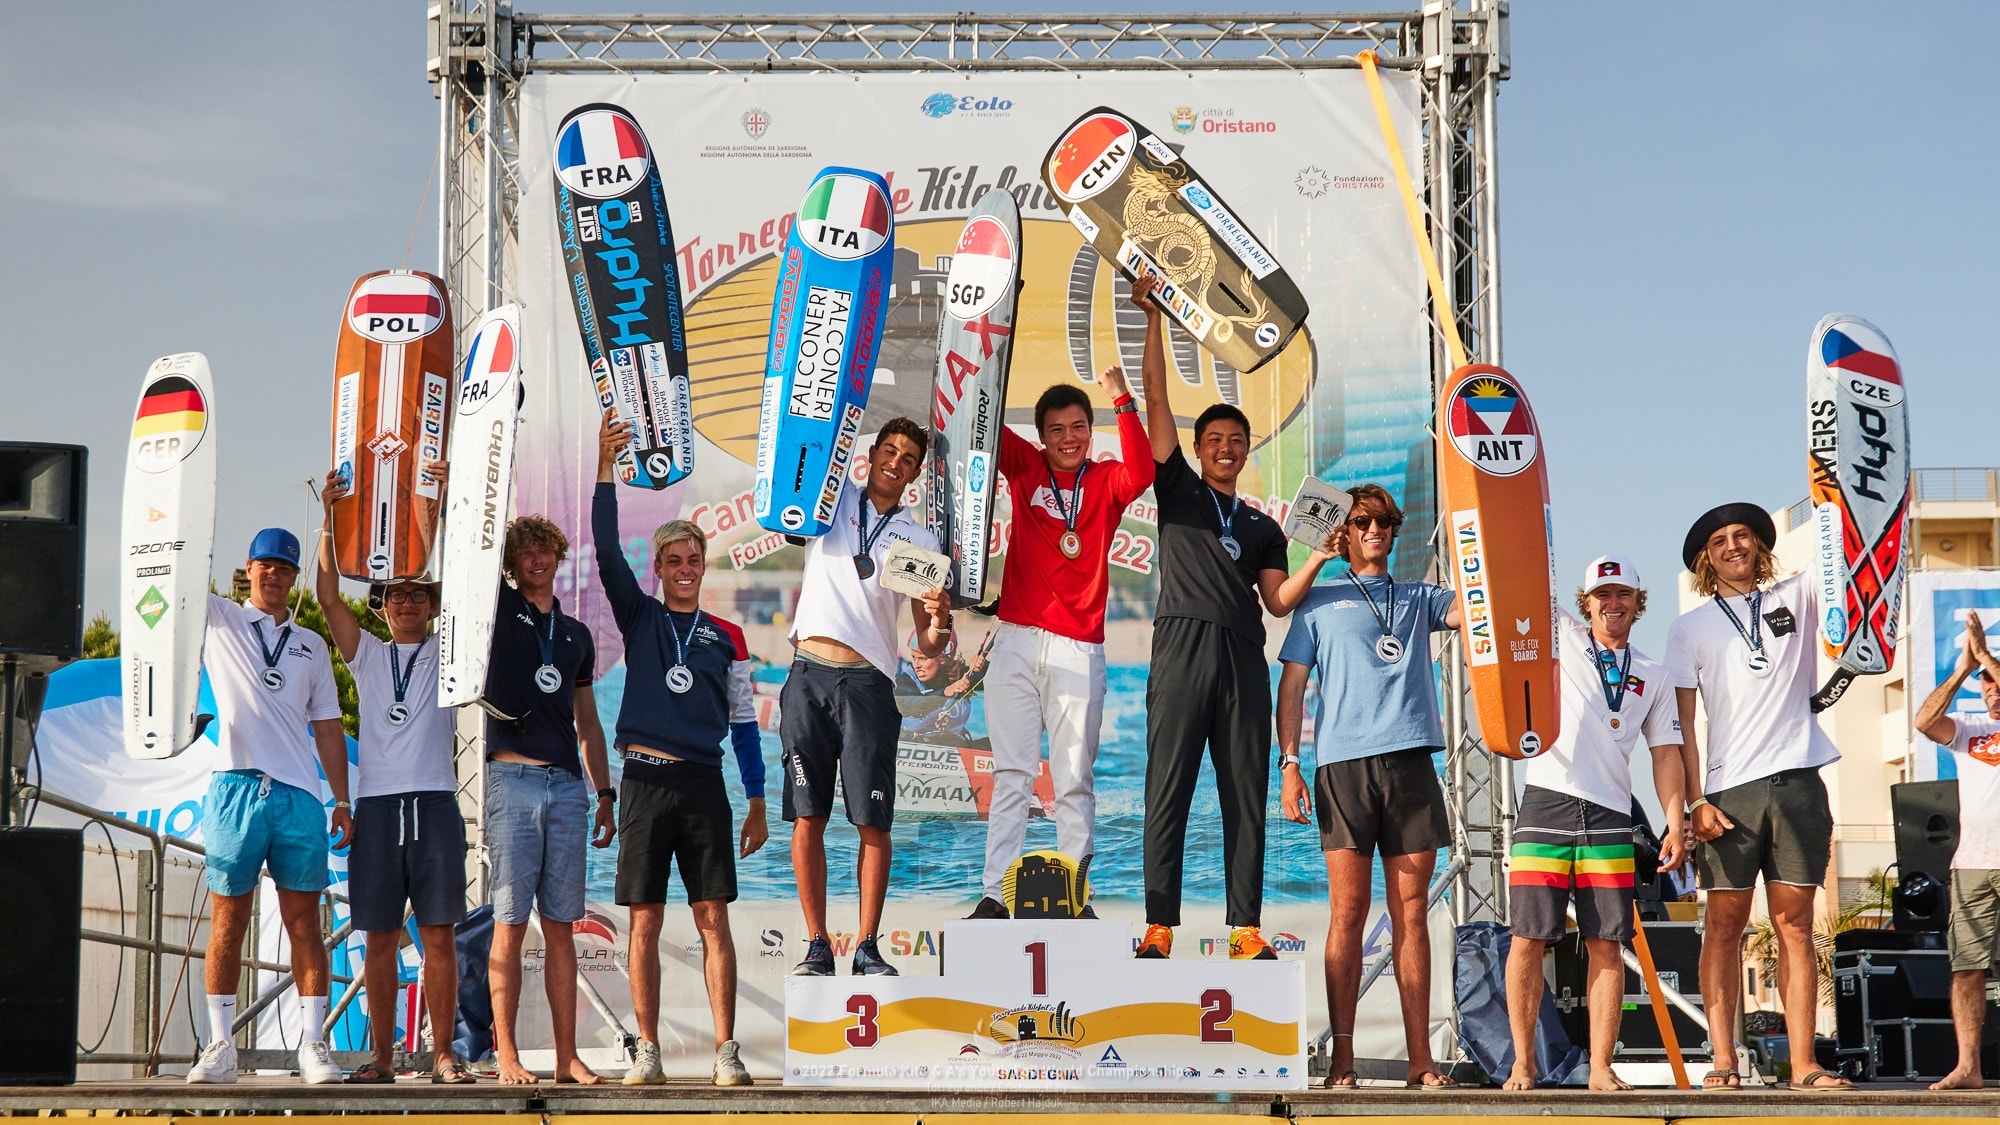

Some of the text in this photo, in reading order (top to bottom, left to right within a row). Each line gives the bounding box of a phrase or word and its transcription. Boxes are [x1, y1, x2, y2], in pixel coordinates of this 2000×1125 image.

[959, 96, 1015, 111] Eolo
[1203, 108, 1234, 117] città di
[1203, 119, 1277, 133] Oristano
[581, 165, 632, 188] FRA
[1081, 144, 1126, 190] CHN
[819, 226, 859, 249] ITA
[1212, 207, 1273, 272] TORREGRANDE
[1217, 227, 1247, 259] ORISTANO
[573, 271, 596, 335] KITECENTER
[663, 262, 684, 352] SPOT KITECENTER
[775, 247, 800, 349] GROOVE
[951, 284, 985, 305] SGP
[369, 317, 420, 333] POL
[790, 286, 828, 417] FALCONERI
[813, 290, 853, 421] FALCONERI
[460, 380, 489, 405] FRA
[620, 369, 631, 404] BANQUE
[627, 368, 640, 415] POPULAIRE
[651, 380, 665, 427] POPULAIRE
[660, 391, 671, 426] BANQUE
[1851, 380, 1891, 402] CZE
[339, 379, 351, 460] TORREGRANDE
[671, 400, 680, 447] ORISTANO
[678, 376, 692, 473] TORREGRANDE
[758, 382, 774, 474] TORREGRANDE
[973, 388, 990, 449] Robline
[138, 437, 181, 458] GER
[815, 405, 862, 521] SARDEGNA
[1477, 440, 1523, 461] ANT
[481, 420, 504, 551] CHUBANGA
[961, 520, 970, 567] ORISTANO
[968, 498, 982, 594] TORREGRANDE
[1820, 507, 1835, 603] TORREGRANDE
[137, 566, 171, 577] PROLIMIT
[1459, 520, 1492, 654] SARDEGNA
[1511, 638, 1540, 651] BLUE FOX
[1513, 651, 1539, 662] BOARDS
[1819, 677, 1849, 707] Hydro
[793, 755, 807, 787] Slam
[1042, 896, 1049, 912] 1
[1023, 941, 1047, 996] 1
[846, 993, 879, 1048] 3
[1200, 988, 1234, 1043] 2
[998, 1068, 1080, 1081] SARDEGNA
